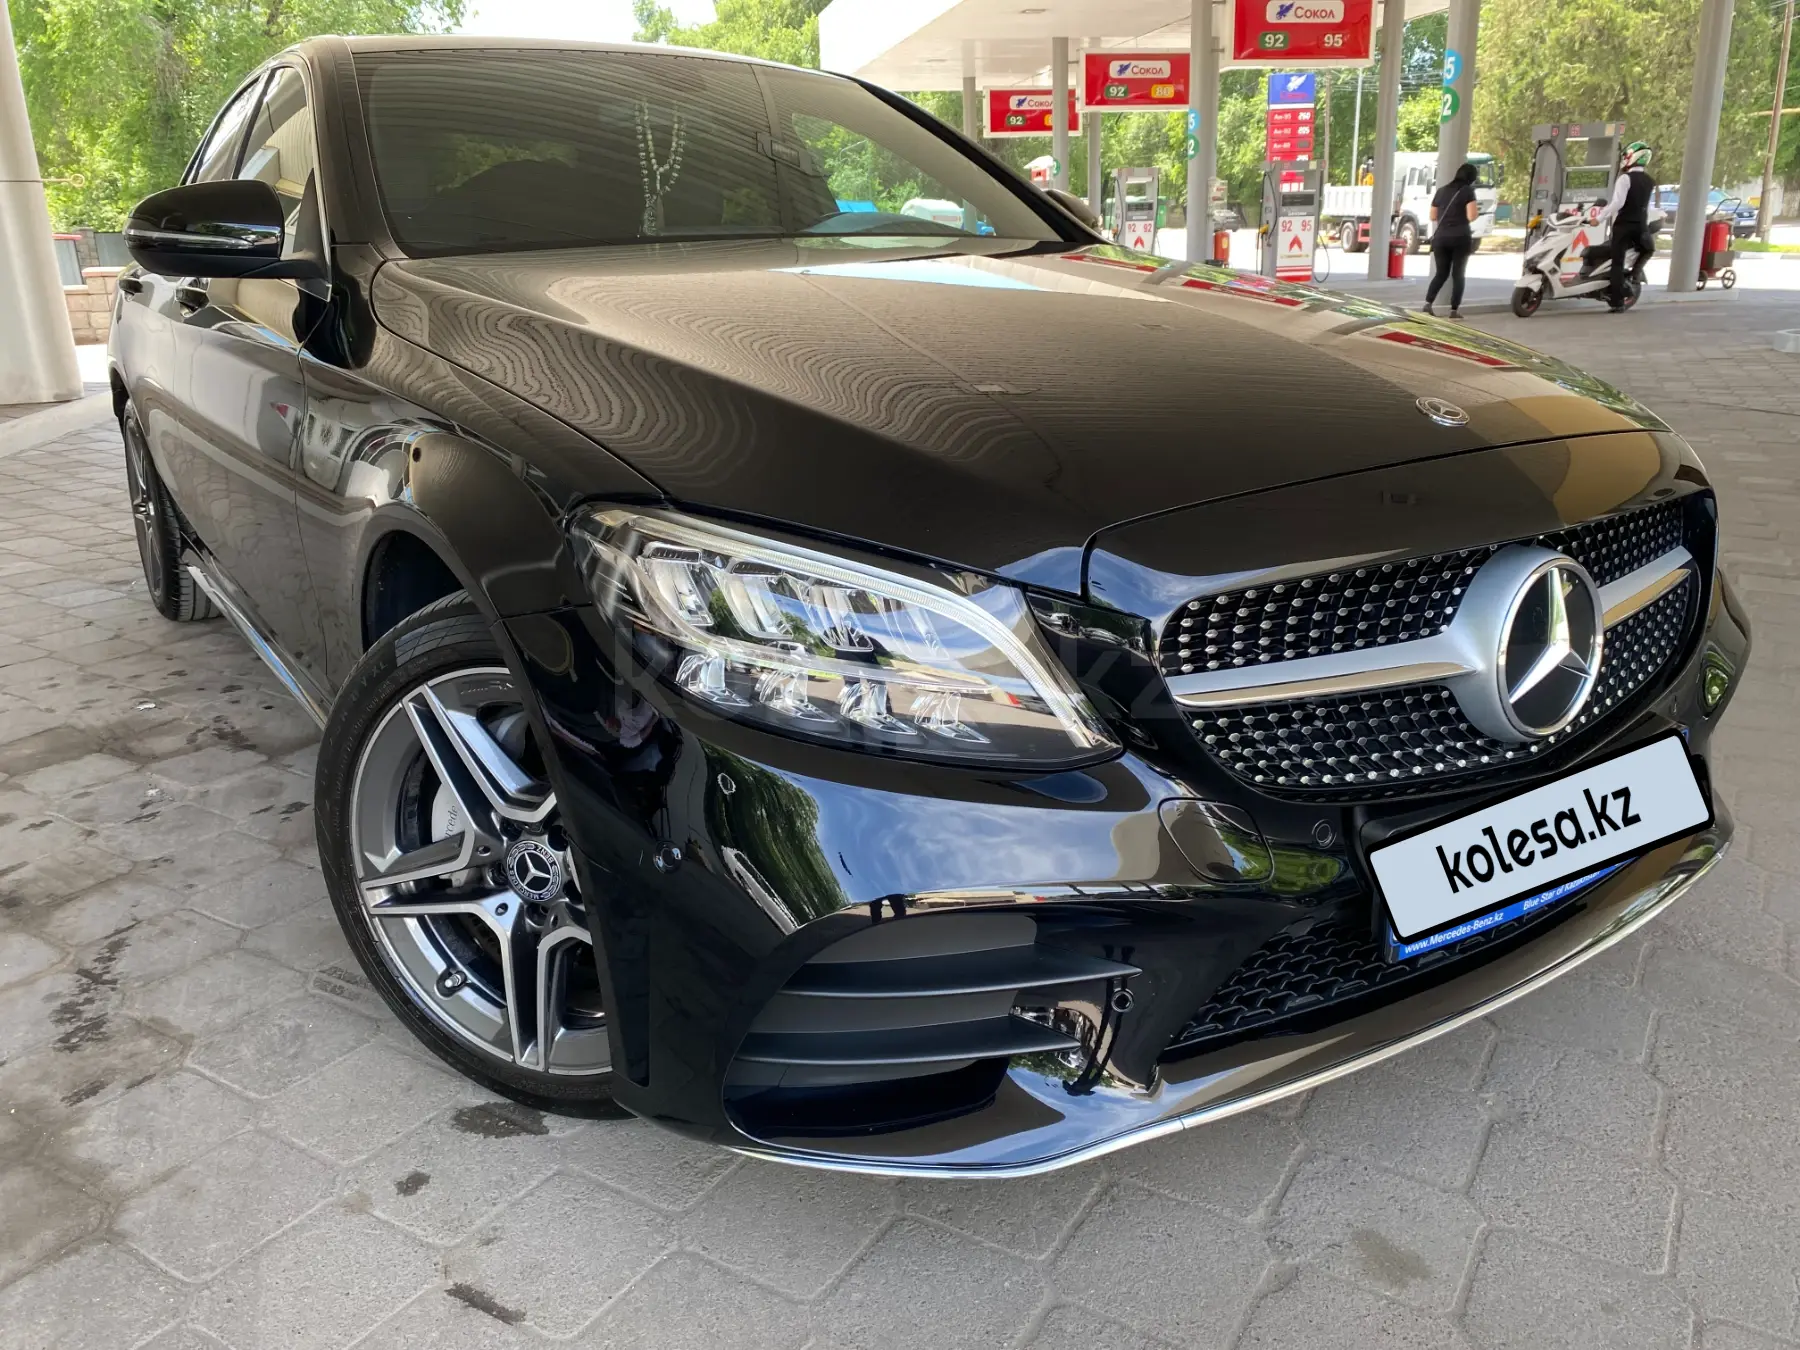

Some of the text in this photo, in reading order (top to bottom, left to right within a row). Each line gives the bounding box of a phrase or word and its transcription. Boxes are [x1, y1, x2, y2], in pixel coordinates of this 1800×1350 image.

[1294, 6, 1335, 19] Сокол
[1265, 34, 1343, 47] 92 95
[1131, 65, 1164, 75] Сокол
[1446, 56, 1455, 79] 5
[1109, 86, 1125, 97] 92
[1443, 94, 1452, 116] 2
[1010, 116, 1023, 125] 92
[1143, 223, 1152, 233] 92
[1281, 219, 1312, 232] 92 95
[536, 845, 555, 863] BENZ
[1405, 912, 1504, 954] www.Mercedes-Benz.kz
[1523, 897, 1540, 910] Blue
[1540, 890, 1556, 903] Star
[1556, 884, 1565, 896] of
